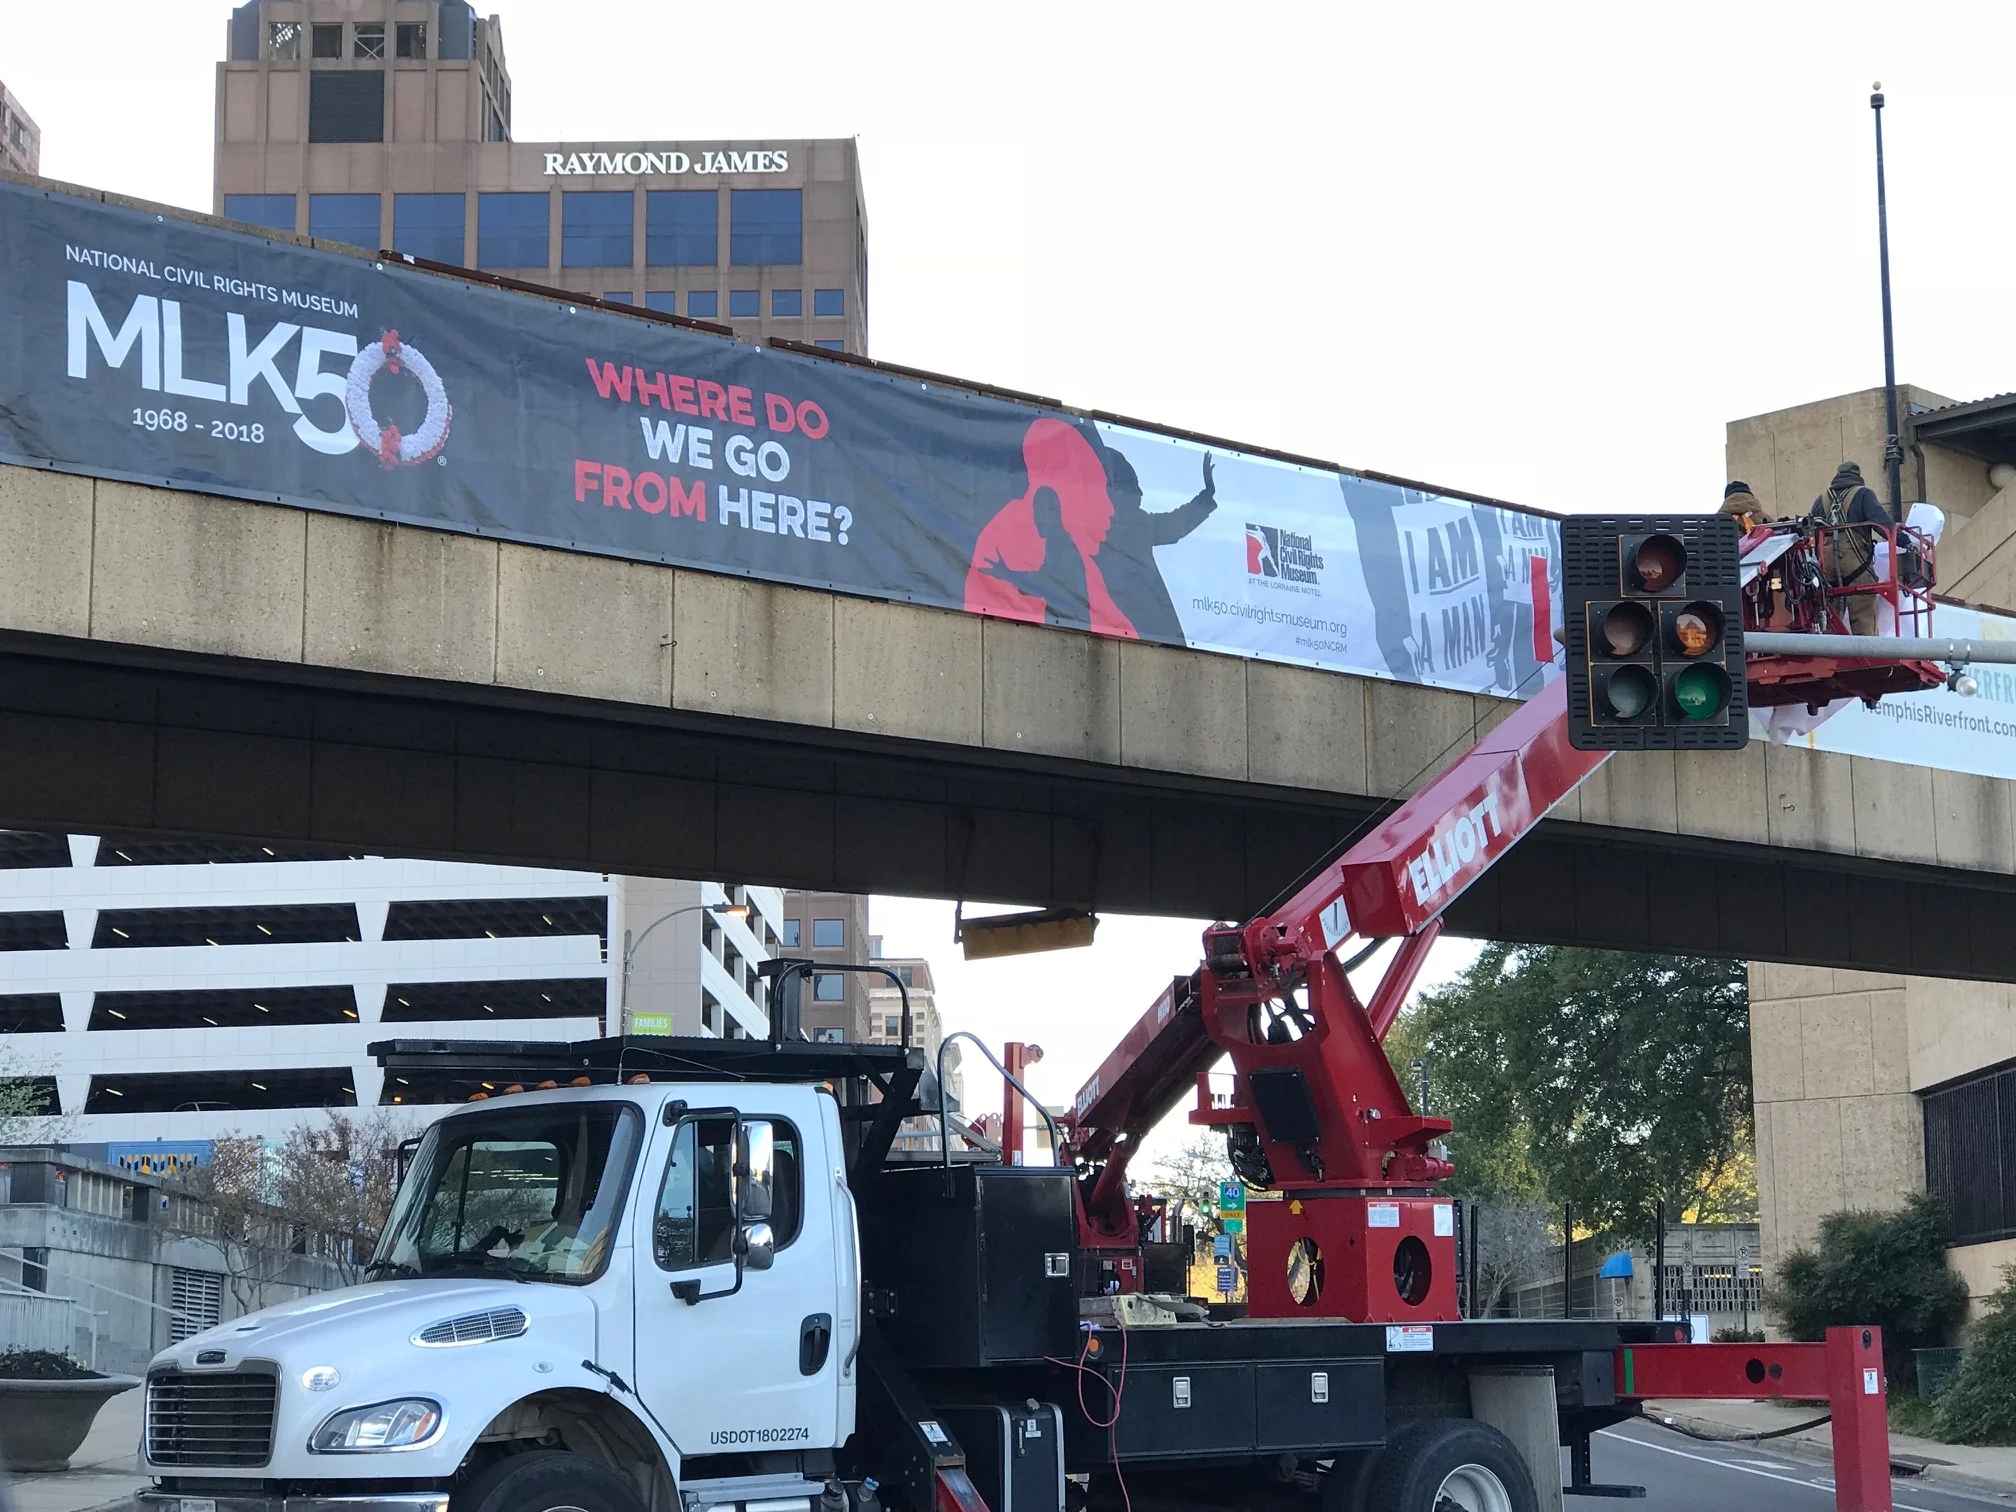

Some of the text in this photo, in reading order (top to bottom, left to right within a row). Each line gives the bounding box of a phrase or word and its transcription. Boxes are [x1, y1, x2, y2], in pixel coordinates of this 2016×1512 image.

[543, 150, 789, 175] RAYMOND JAMES
[66, 244, 358, 319] NATIONAL CIVIL RIGHTS MUSEUM
[585, 358, 830, 440] WHERE DO
[132, 406, 189, 433] 1968
[211, 419, 266, 445] 2018
[640, 416, 791, 483] WE GO
[574, 459, 853, 546] FROM HERE?
[1279, 528, 1312, 552] National
[1511, 510, 1544, 538] AM
[1280, 545, 1325, 571] Civil Rights
[1404, 530, 1420, 594] I
[1427, 516, 1479, 590] AM
[1248, 577, 1322, 597] AT THE LORRAINE MOTEL
[1192, 596, 1348, 638] mlk50.civilrightsmuseum.org
[1420, 593, 1486, 674] A MAN
[1295, 635, 1348, 654] #mlk50NCRM
[1408, 791, 1502, 907] ELLIOTT
[635, 1017, 668, 1029] FAMILIES
[1225, 1187, 1240, 1198] 40
[710, 1427, 810, 1445] USDOT1802274
